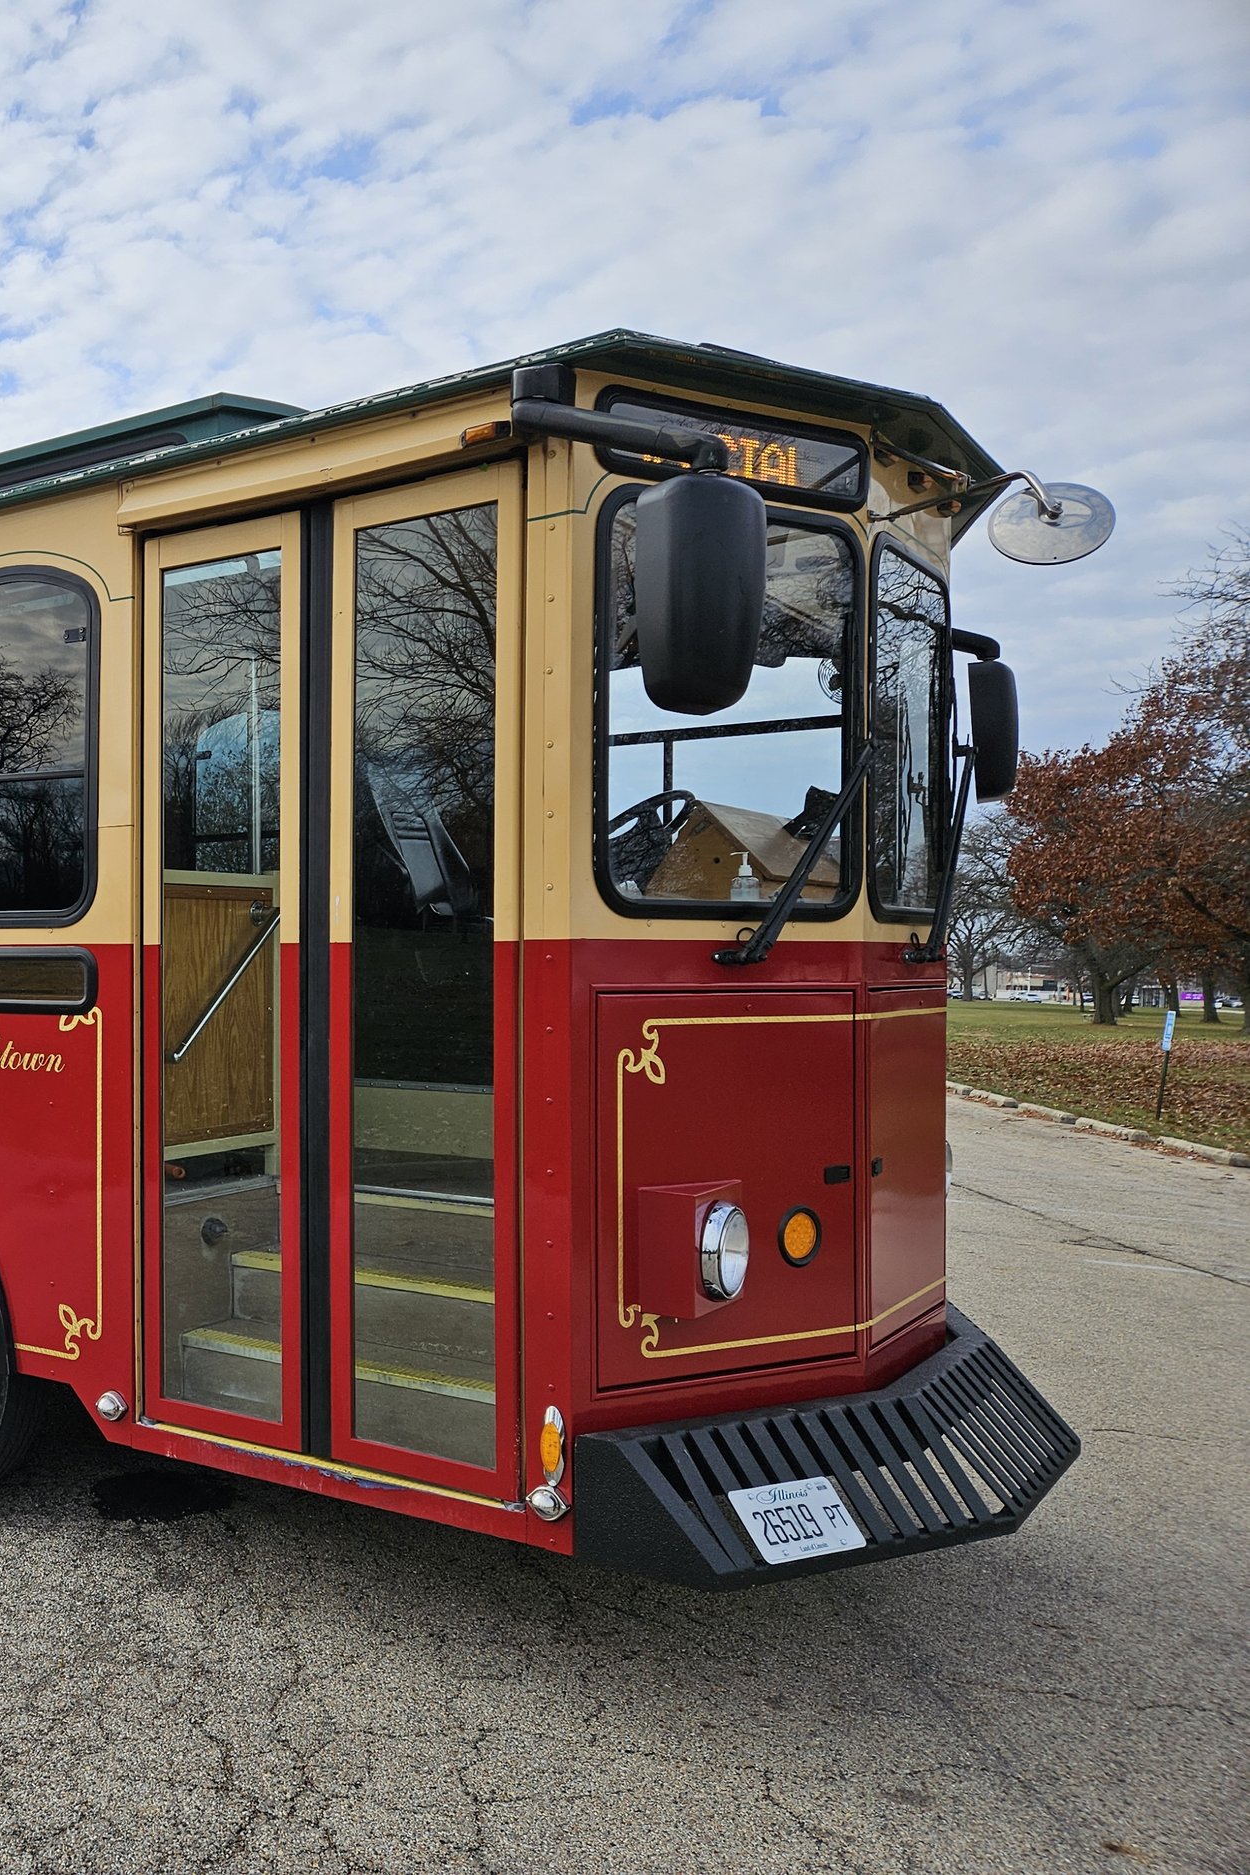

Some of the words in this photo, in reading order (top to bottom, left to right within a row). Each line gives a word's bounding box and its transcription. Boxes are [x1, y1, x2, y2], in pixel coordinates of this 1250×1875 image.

[755, 1487, 808, 1504] Illinois
[752, 1503, 824, 1546] 26519
[822, 1504, 848, 1528] PT
